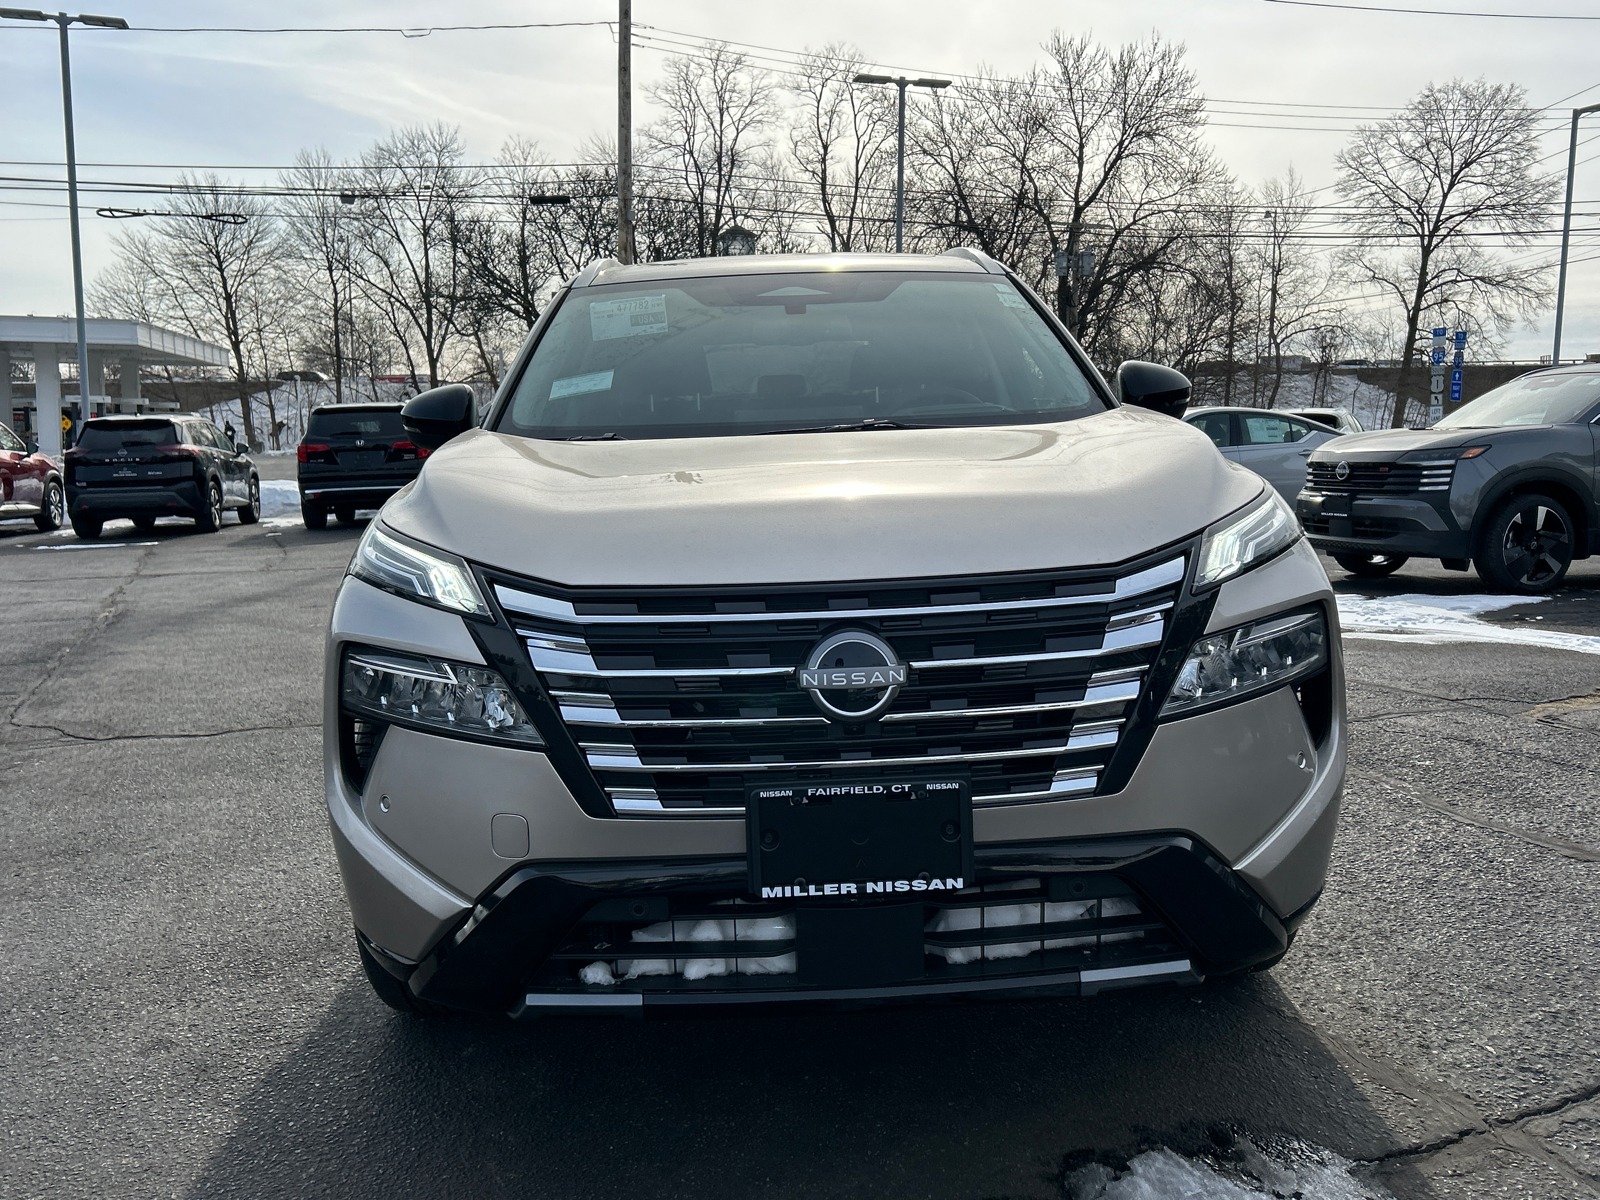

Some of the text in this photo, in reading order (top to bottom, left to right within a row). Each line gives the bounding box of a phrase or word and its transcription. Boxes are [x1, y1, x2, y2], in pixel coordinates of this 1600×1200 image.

[616, 300, 649, 312] 477782
[1433, 352, 1444, 362] 95
[1454, 356, 1463, 365] 95
[803, 668, 905, 686] NISSAN
[760, 782, 959, 798] NISSAN FAIRFIELD, CT NISSAN
[762, 877, 964, 899] MILLER NISSAN
